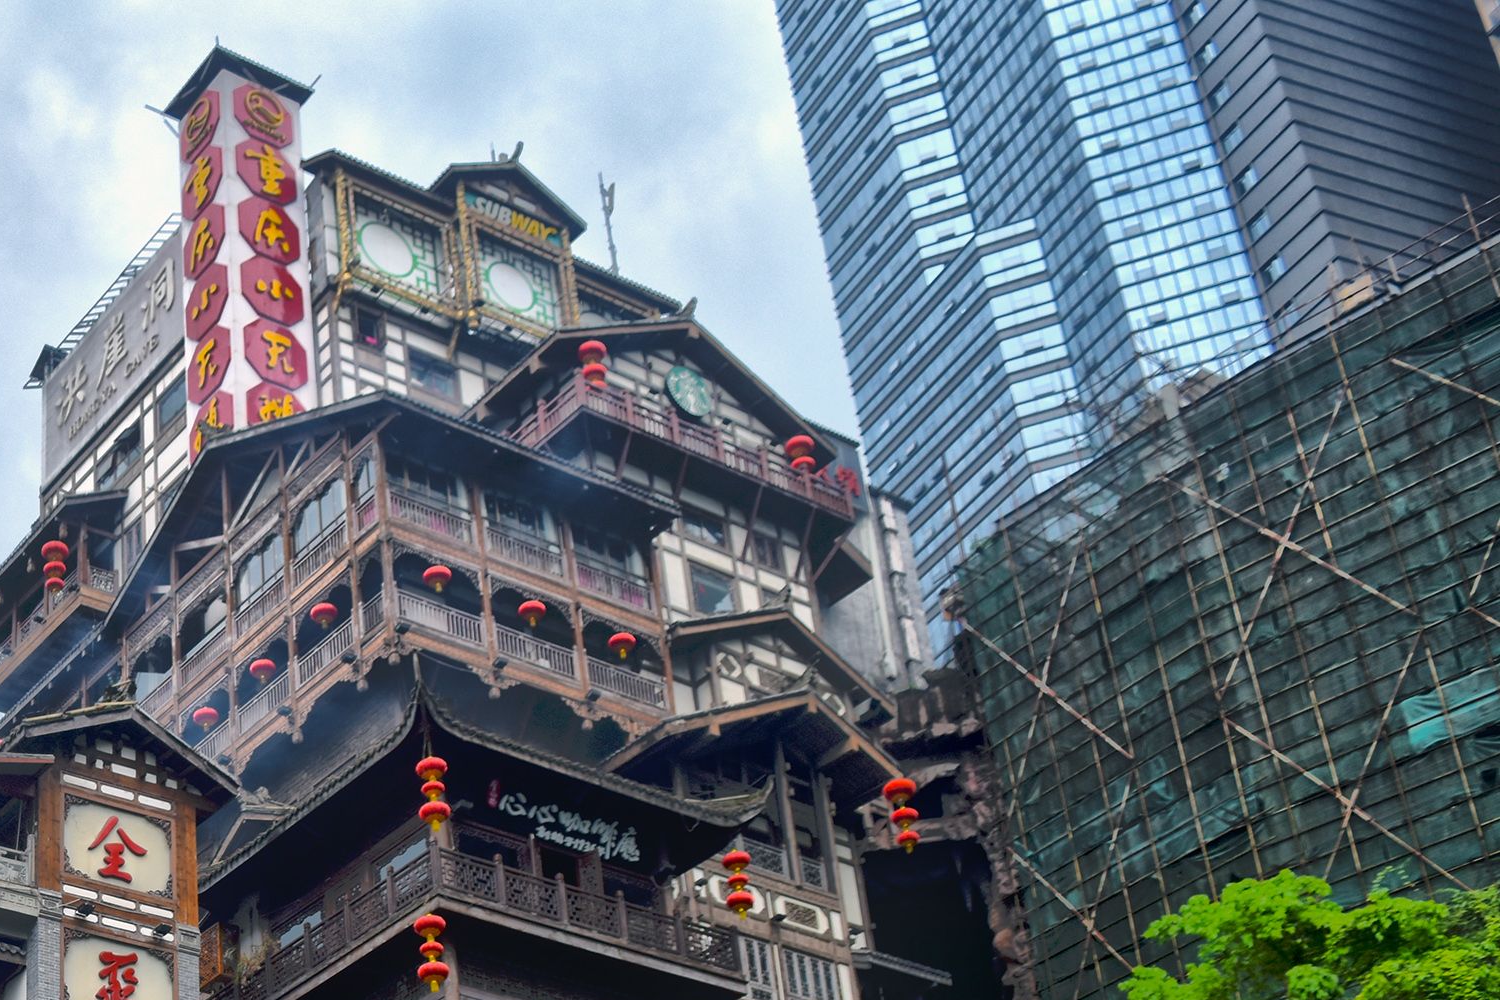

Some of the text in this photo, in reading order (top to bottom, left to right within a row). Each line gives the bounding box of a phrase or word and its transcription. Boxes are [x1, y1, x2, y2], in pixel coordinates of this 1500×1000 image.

[474, 196, 558, 241] SUBWAY
[56, 257, 176, 429] 洪崖洞
